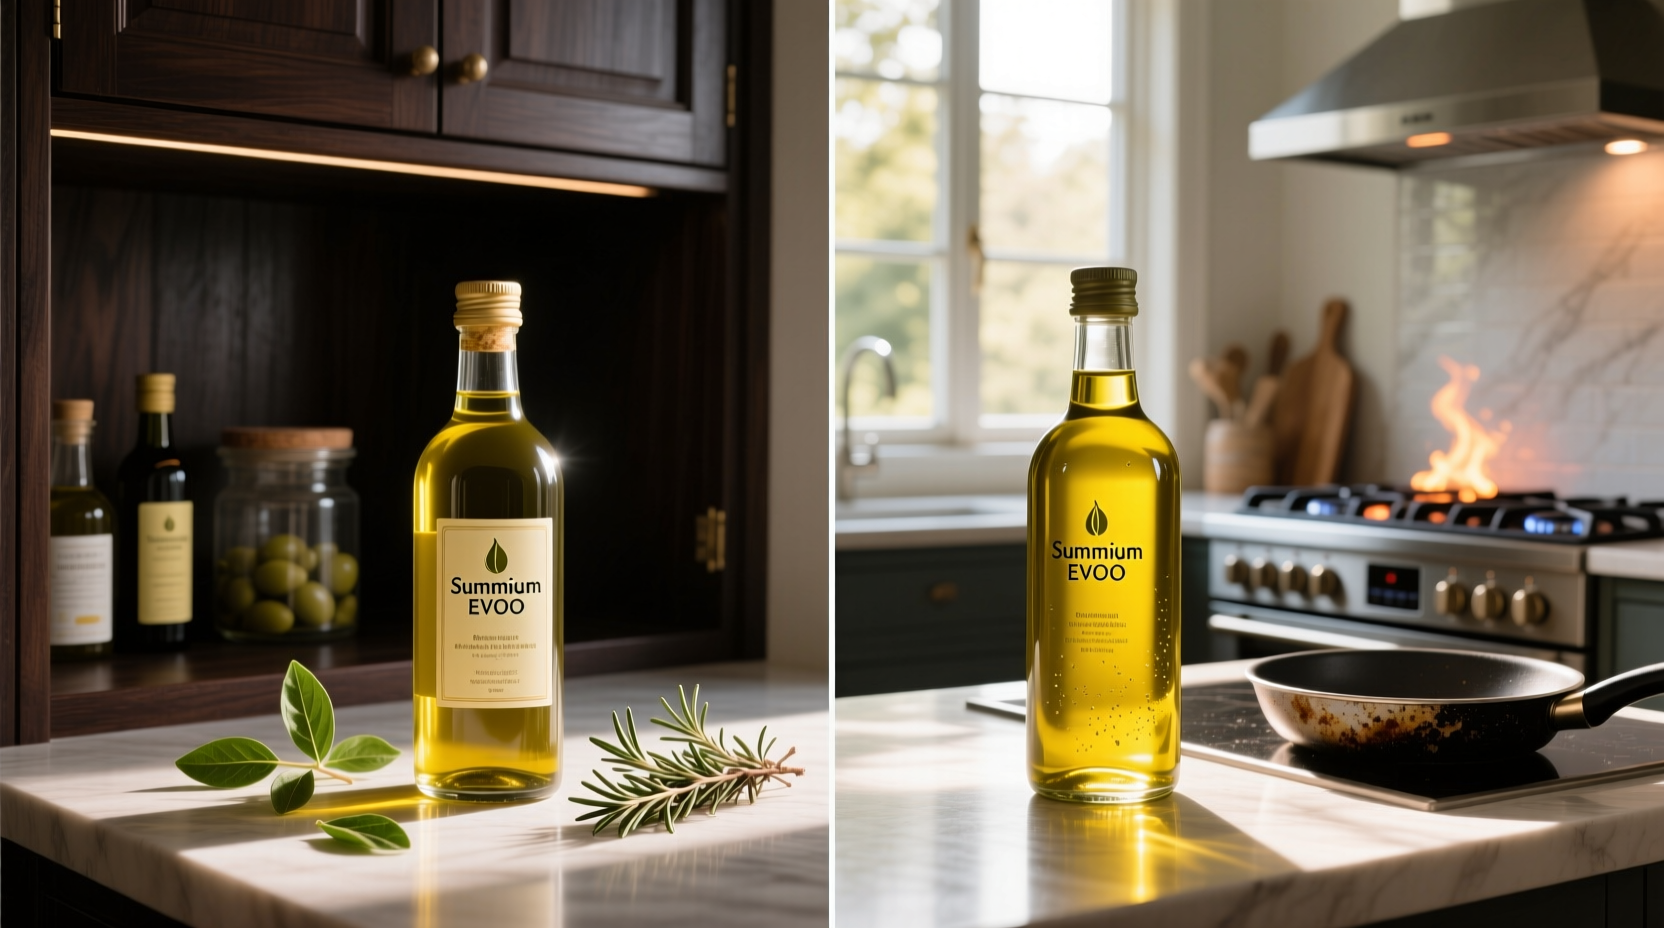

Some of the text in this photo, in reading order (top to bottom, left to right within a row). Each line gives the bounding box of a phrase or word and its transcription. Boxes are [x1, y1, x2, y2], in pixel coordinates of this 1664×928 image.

[1051, 540, 1143, 560] Summium
[1068, 563, 1126, 581] EVOO
[450, 576, 541, 595] Summium
[468, 598, 525, 616] EVOO
